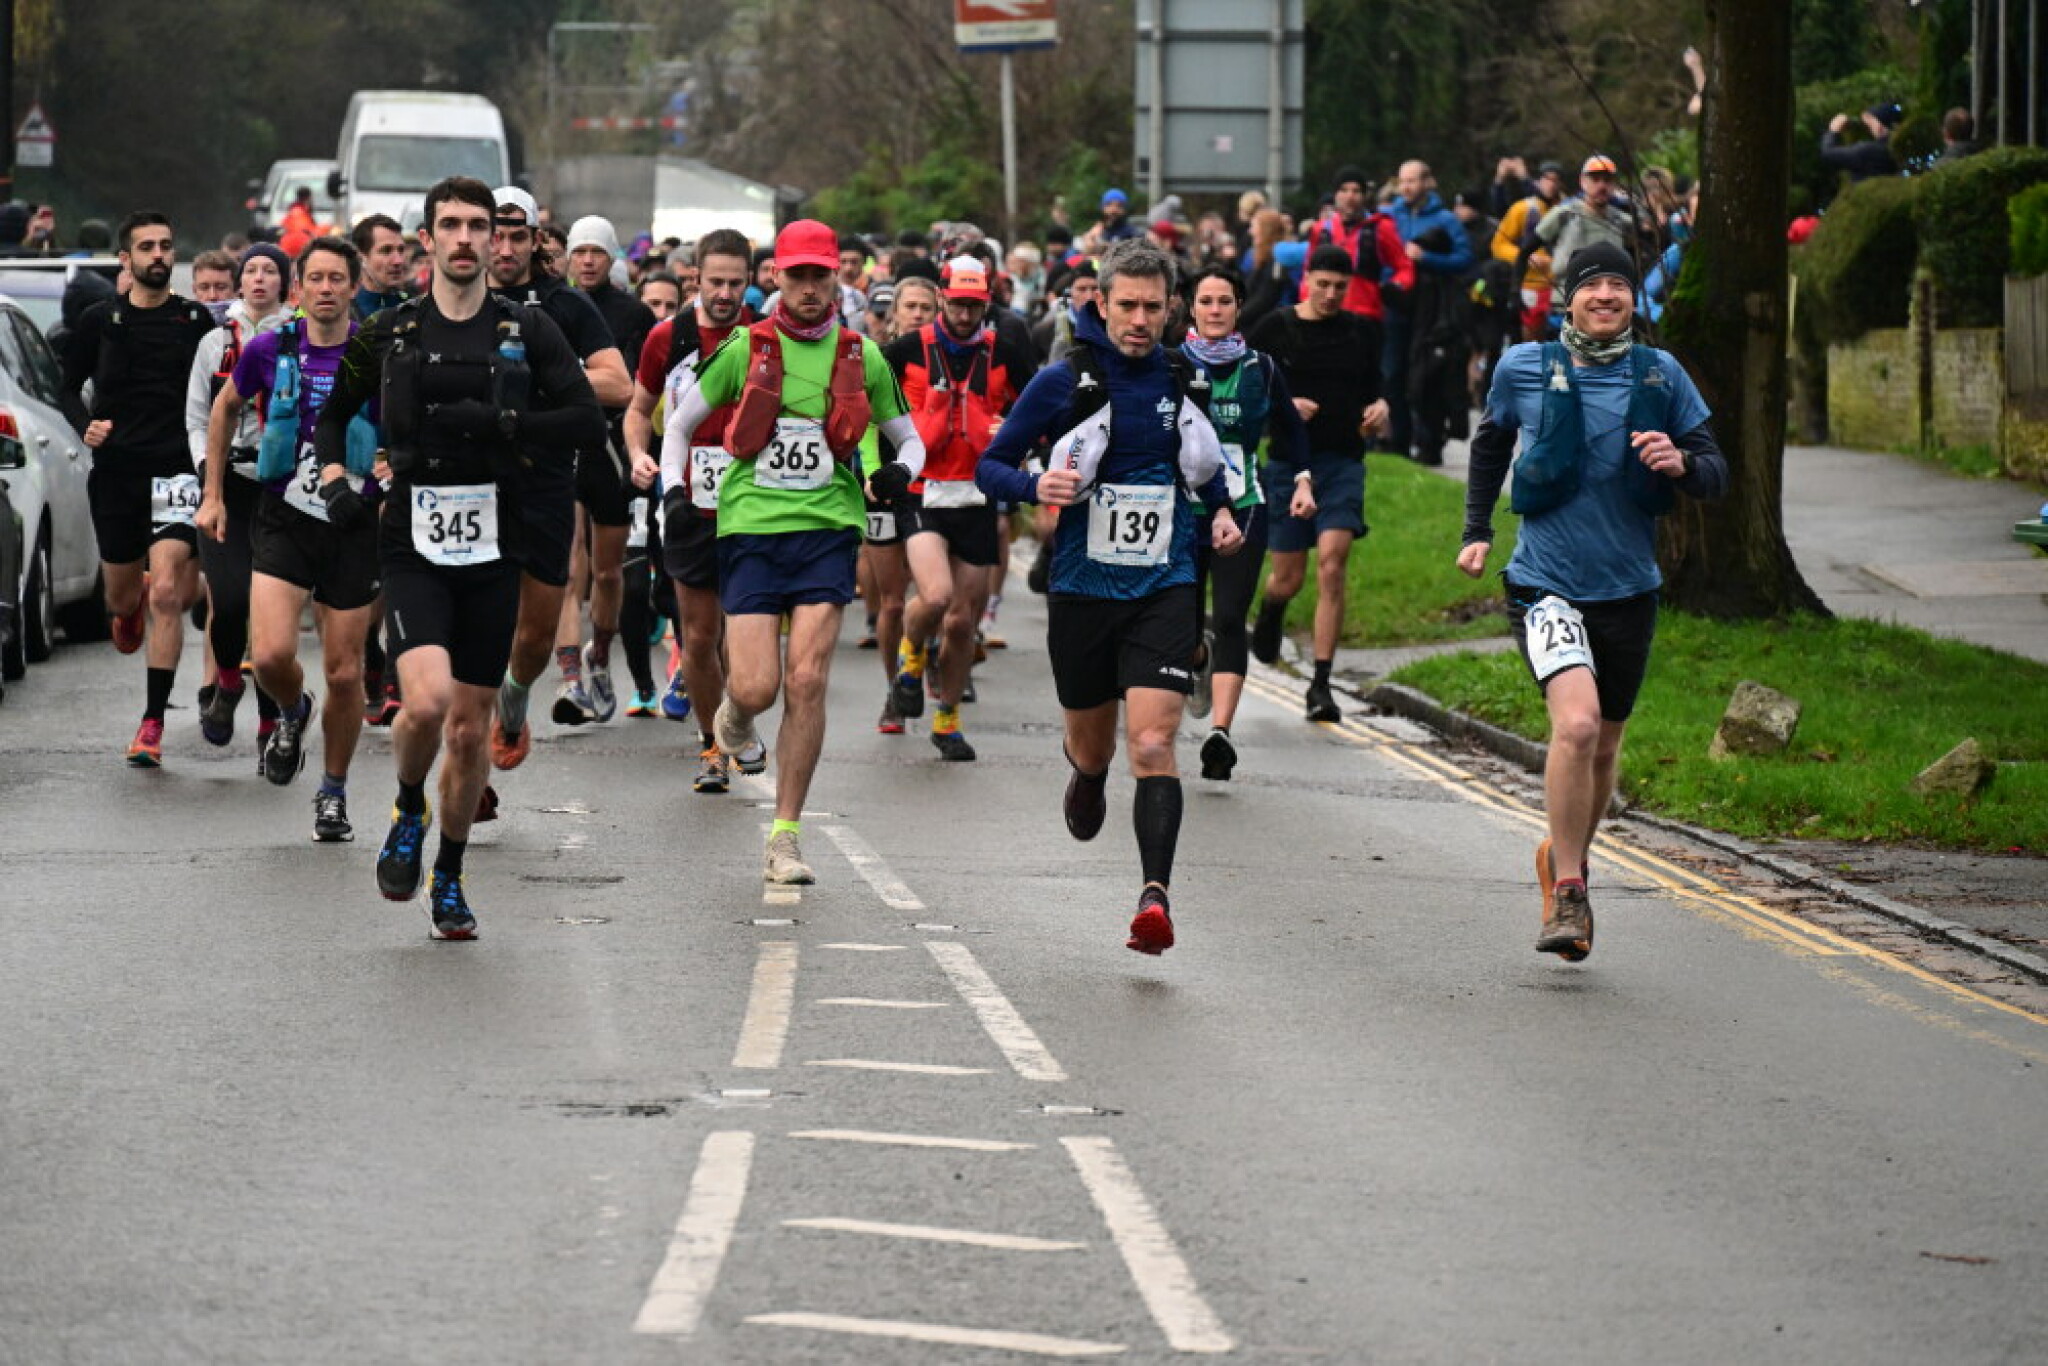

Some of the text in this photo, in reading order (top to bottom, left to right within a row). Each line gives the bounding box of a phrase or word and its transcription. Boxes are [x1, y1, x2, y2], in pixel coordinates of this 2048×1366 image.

[769, 441, 820, 471] 365
[429, 509, 482, 543] 345
[1108, 509, 1160, 544] 139
[1539, 617, 1584, 652] 237
